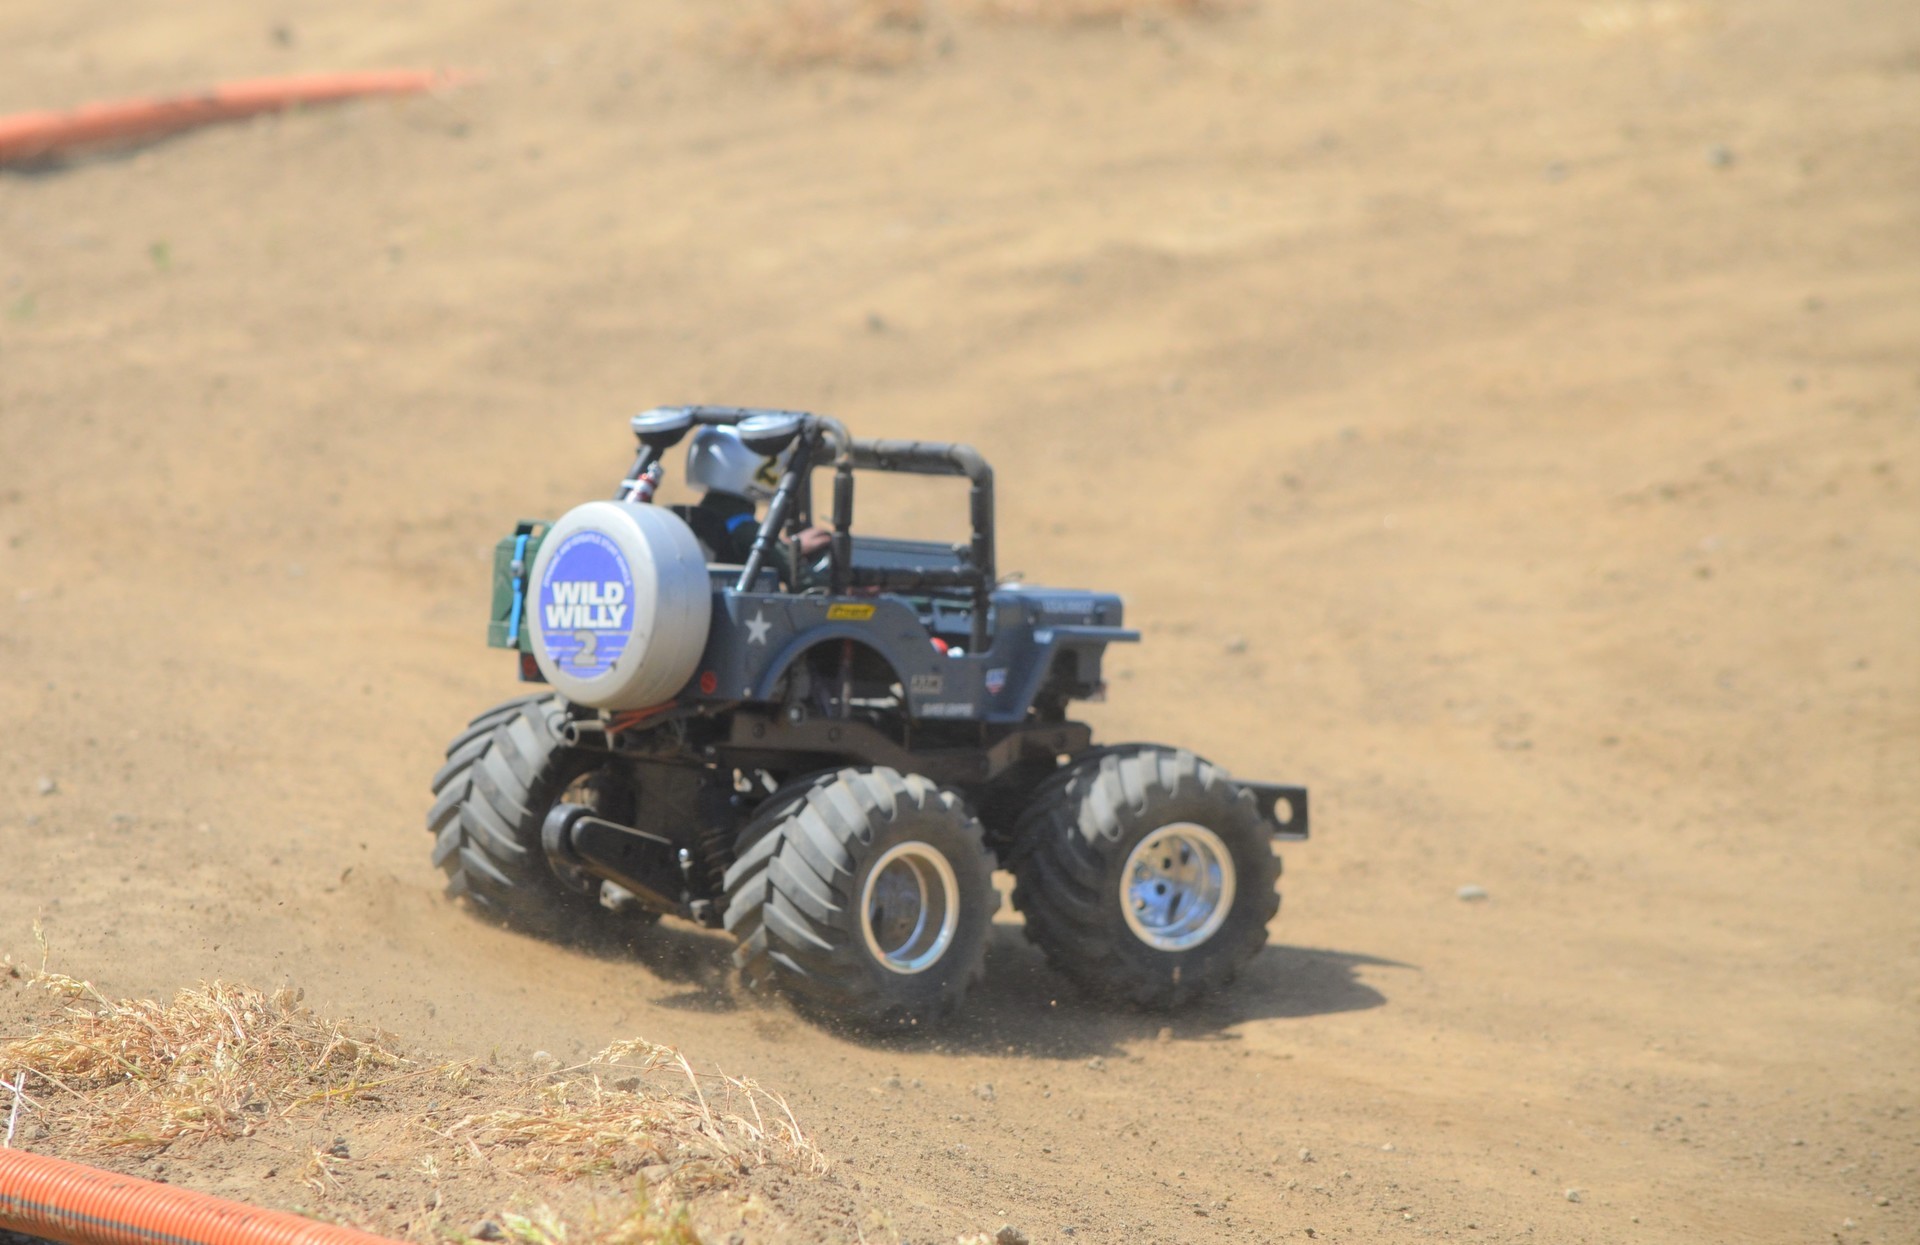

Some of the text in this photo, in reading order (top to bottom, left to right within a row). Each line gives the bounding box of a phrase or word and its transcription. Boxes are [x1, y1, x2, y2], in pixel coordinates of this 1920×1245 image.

[552, 581, 625, 605] WILD
[545, 605, 628, 629] WILLY
[572, 629, 598, 667] 2
